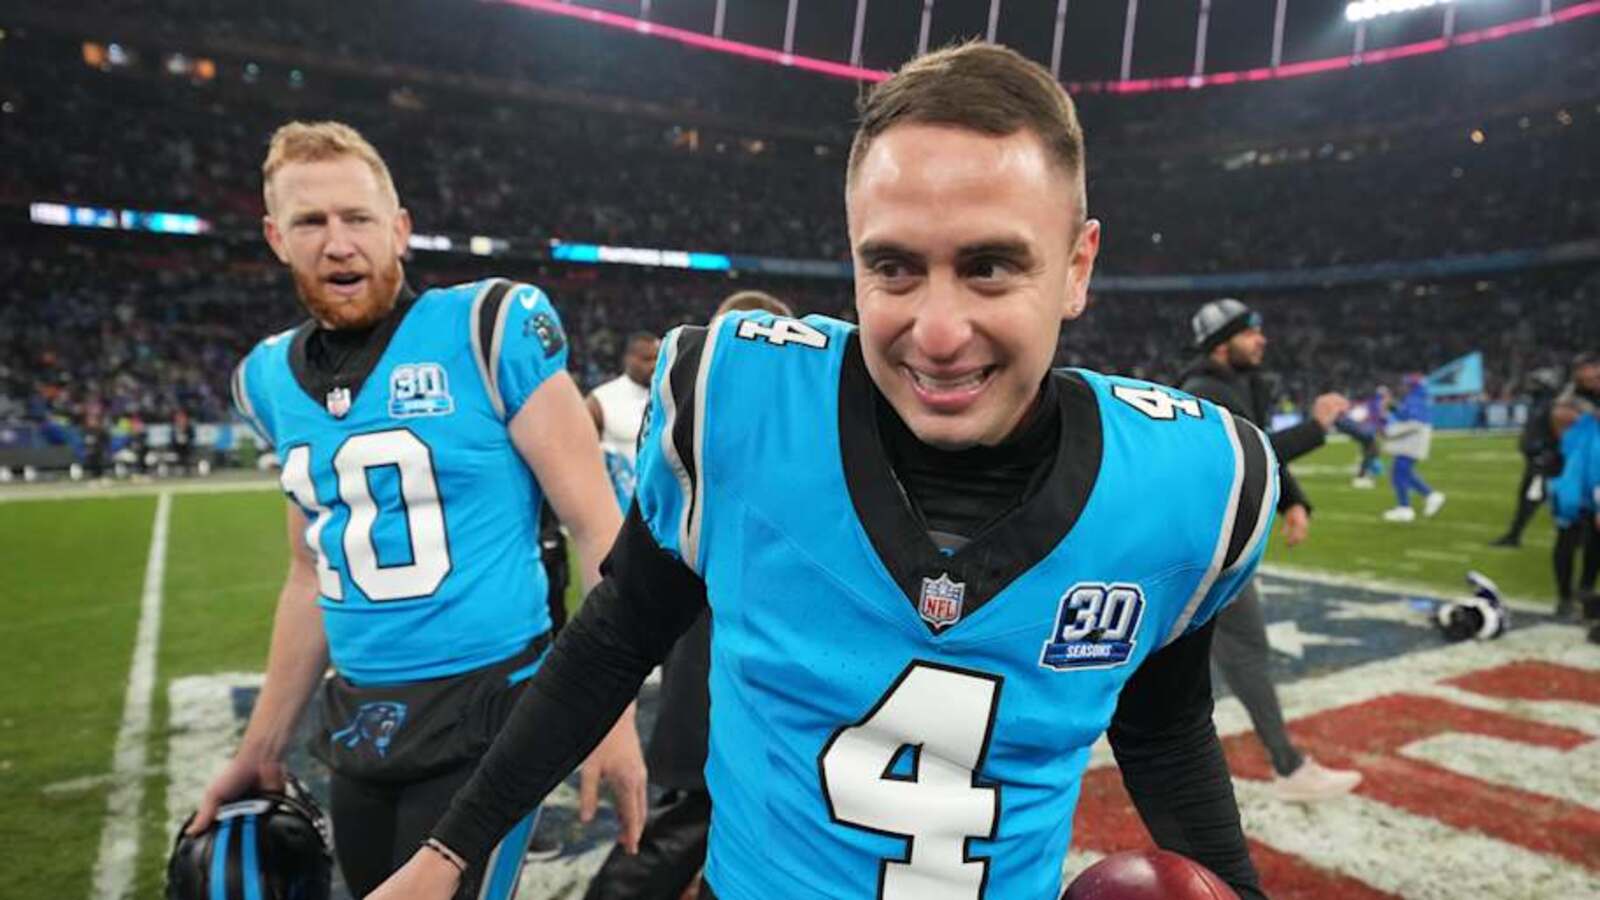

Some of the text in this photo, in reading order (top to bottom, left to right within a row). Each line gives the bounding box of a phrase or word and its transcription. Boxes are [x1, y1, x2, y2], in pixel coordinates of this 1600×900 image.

[736, 319, 830, 350] 4
[1111, 383, 1204, 421] 4
[280, 427, 453, 604] 10
[923, 596, 957, 620] NFL
[1062, 587, 1138, 641] 30
[816, 658, 1005, 900] 4
